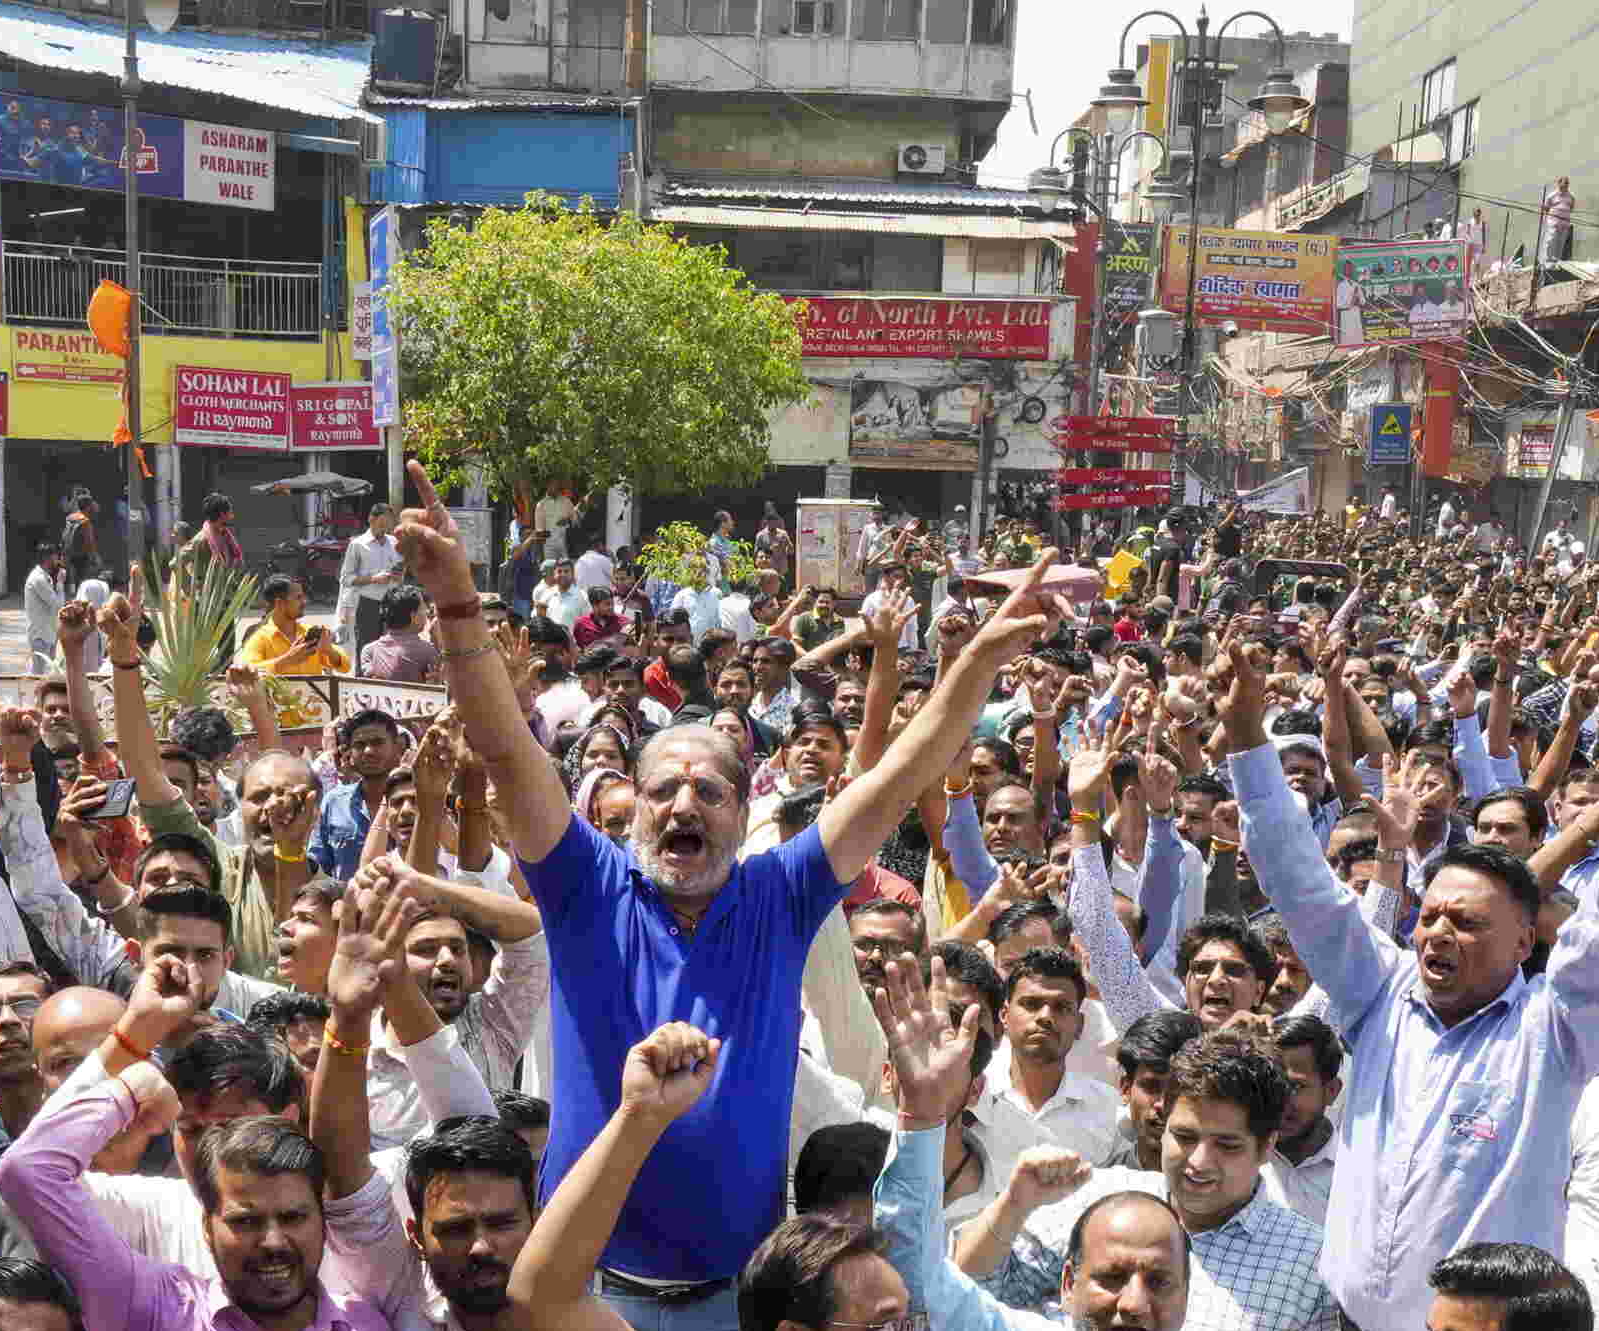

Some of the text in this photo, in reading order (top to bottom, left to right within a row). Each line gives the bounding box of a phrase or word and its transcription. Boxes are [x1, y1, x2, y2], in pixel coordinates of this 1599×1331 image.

[202, 130, 268, 153] ASHARAM
[200, 156, 269, 178] PARANTHE
[218, 182, 254, 201] WALE
[869, 301, 939, 325] North
[946, 302, 992, 325] Pvt.
[1002, 302, 1050, 326] Ltd.
[181, 371, 286, 397] SOHAN LAL
[181, 396, 285, 413] CLOTH MERCHANTS
[315, 412, 358, 425] & SON
